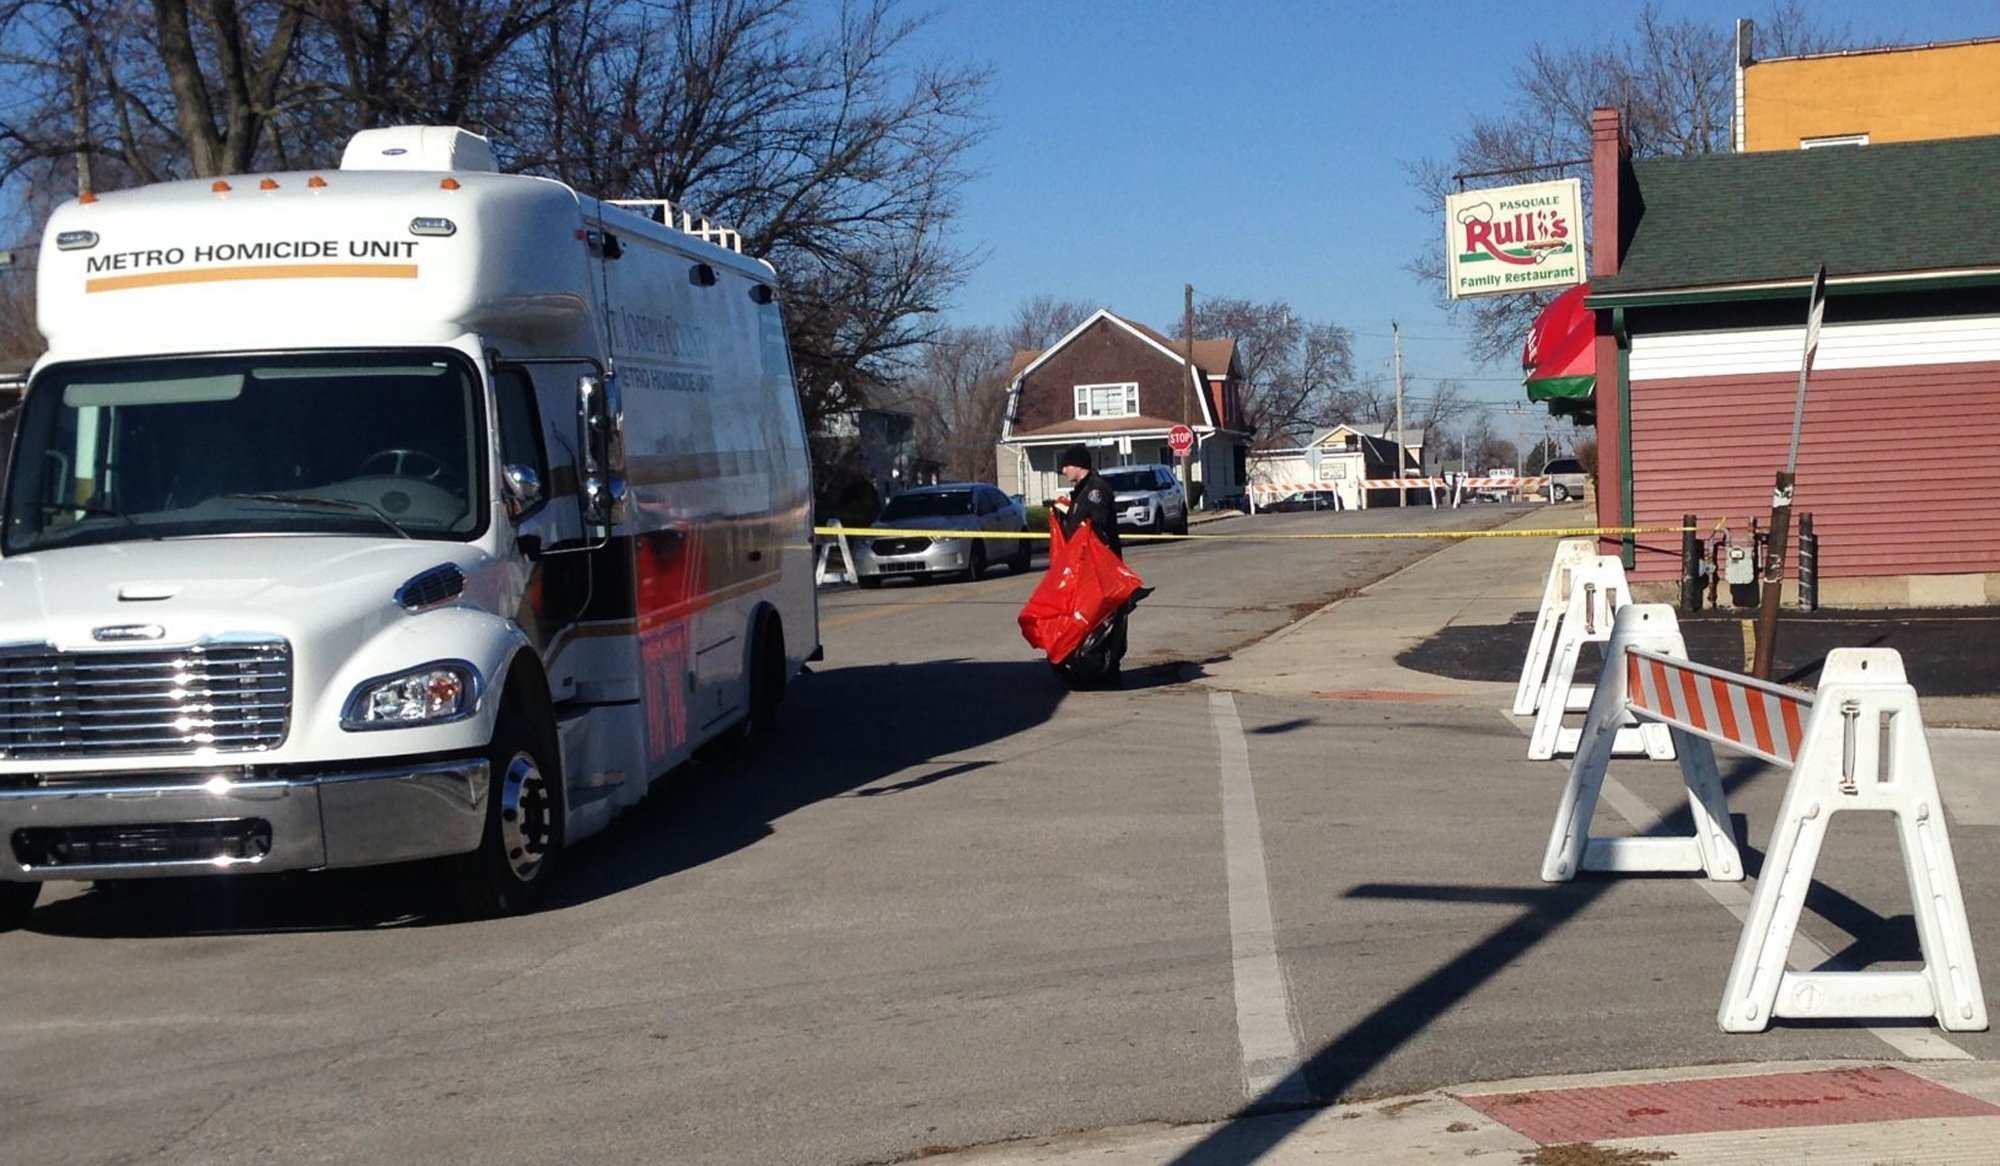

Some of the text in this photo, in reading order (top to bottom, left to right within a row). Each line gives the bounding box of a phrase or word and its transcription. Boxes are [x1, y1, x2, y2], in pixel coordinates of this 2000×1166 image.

[1499, 196, 1560, 210] PASQUALE
[86, 240, 419, 272] METRO HOMICIDE UNIT
[1460, 266, 1575, 288] Family Restaurant
[1170, 431, 1191, 444] STOP
